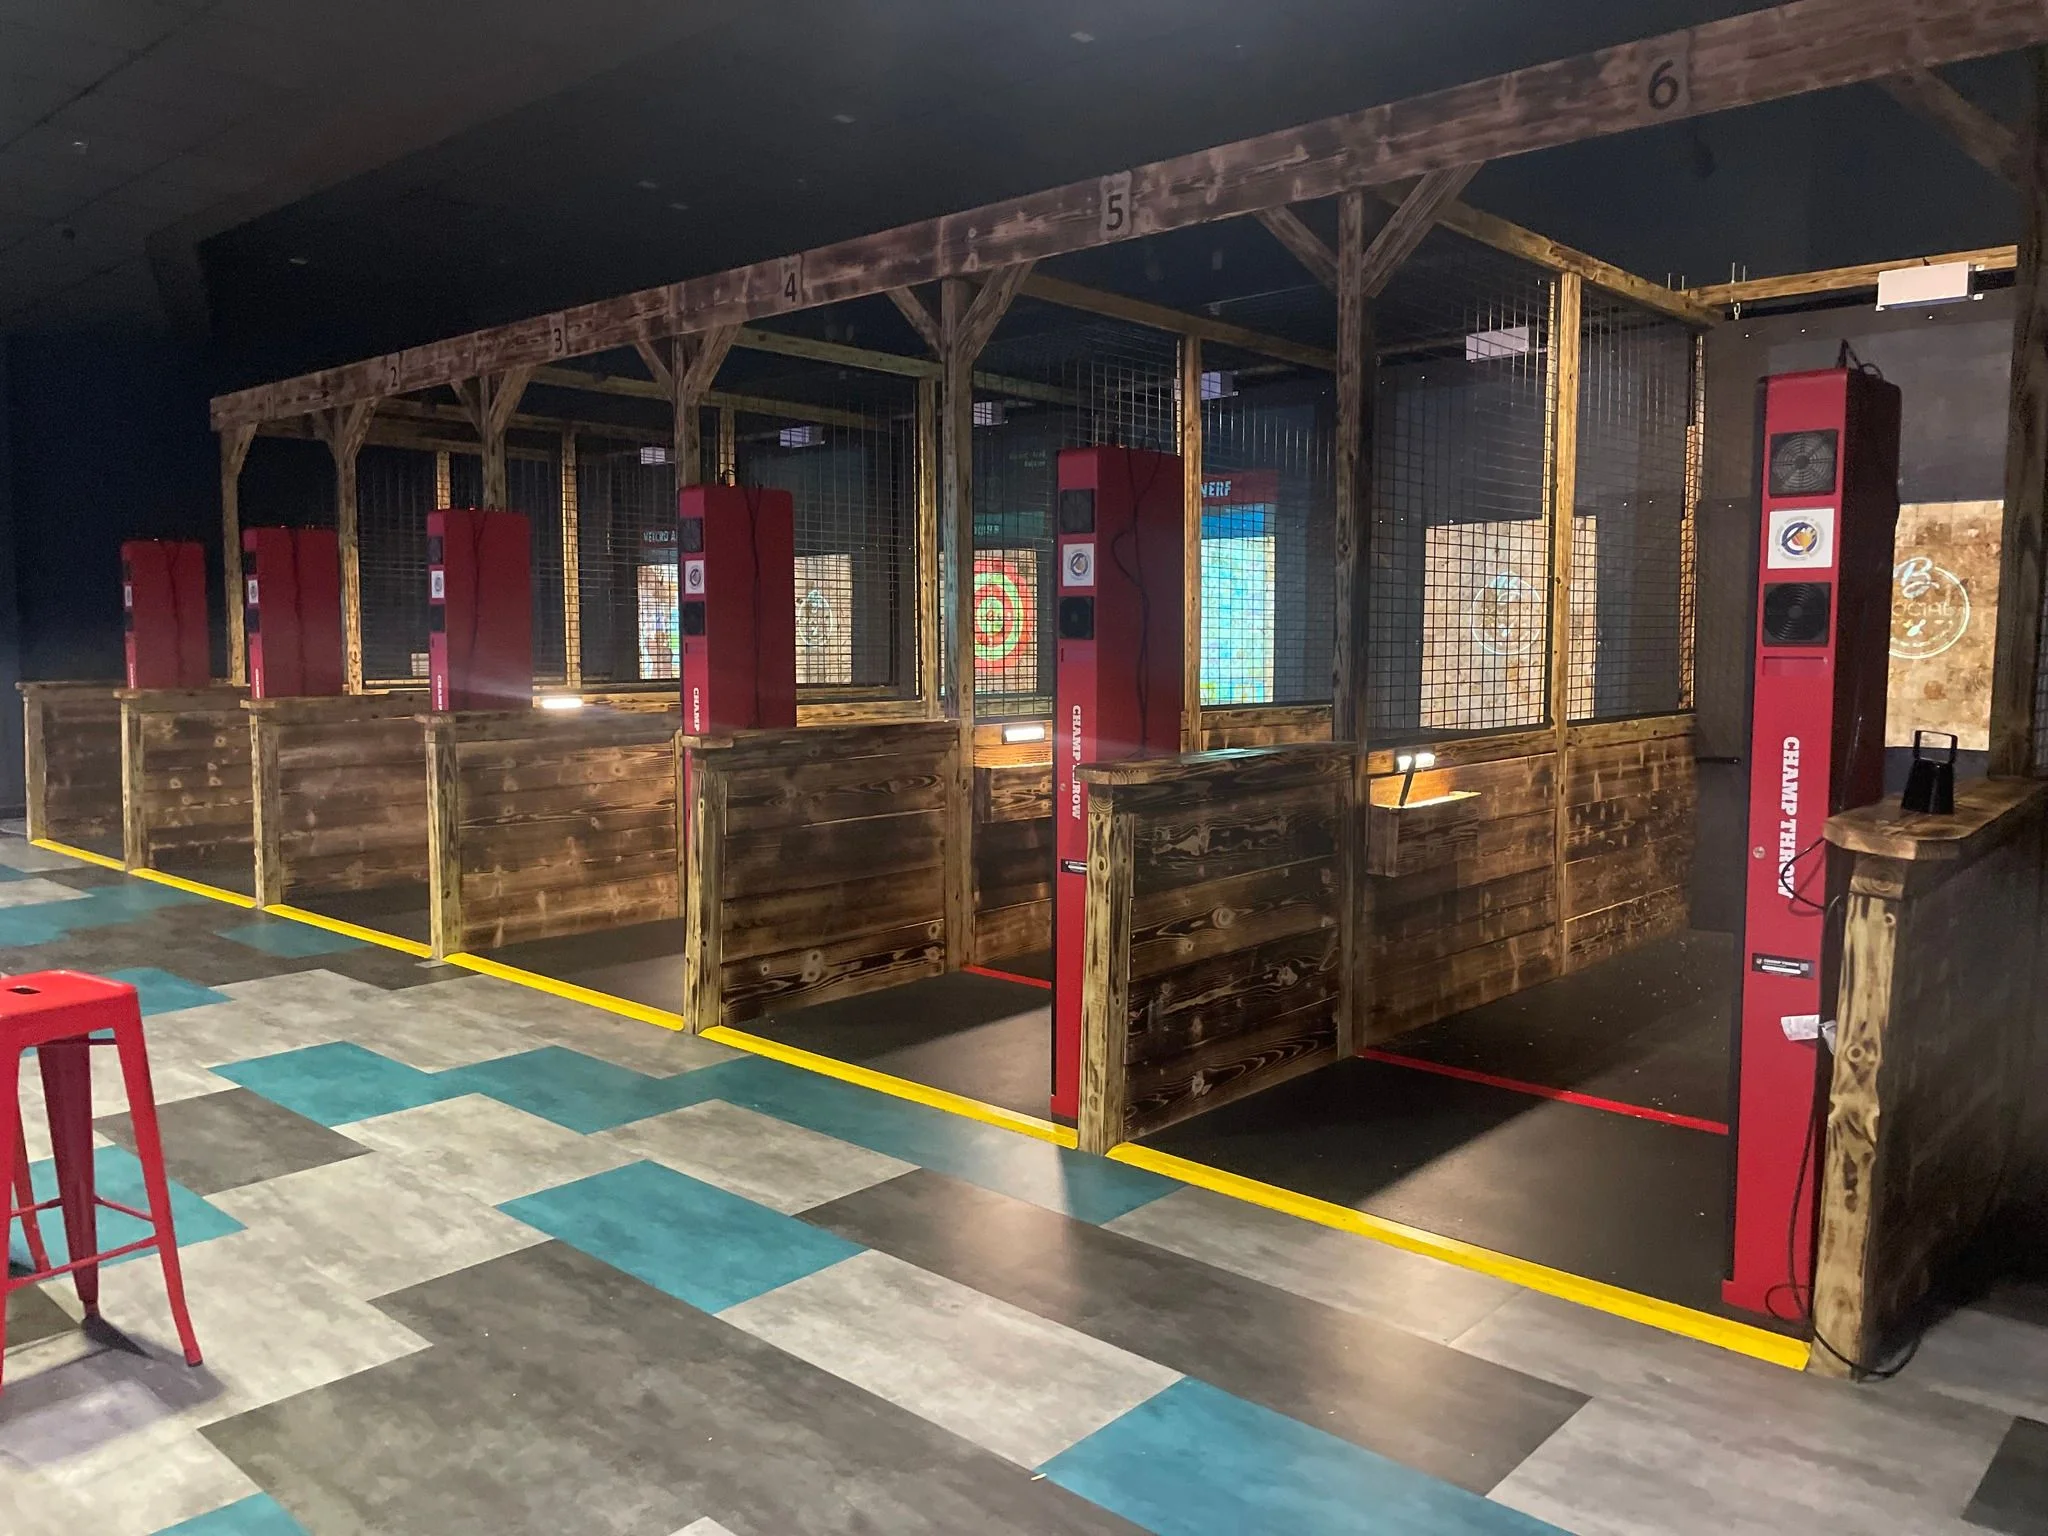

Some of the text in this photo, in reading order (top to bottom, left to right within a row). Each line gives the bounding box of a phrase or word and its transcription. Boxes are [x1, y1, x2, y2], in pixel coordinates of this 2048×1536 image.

[1648, 59, 1679, 110] 6
[1106, 193, 1123, 231] 5
[784, 272, 797, 302] 4
[554, 327, 562, 352] 3
[390, 366, 398, 387] 2
[1200, 480, 1232, 498] NERF
[1072, 704, 1081, 820] CHAMP ROW
[1777, 736, 1800, 899] CHAMP THROW
